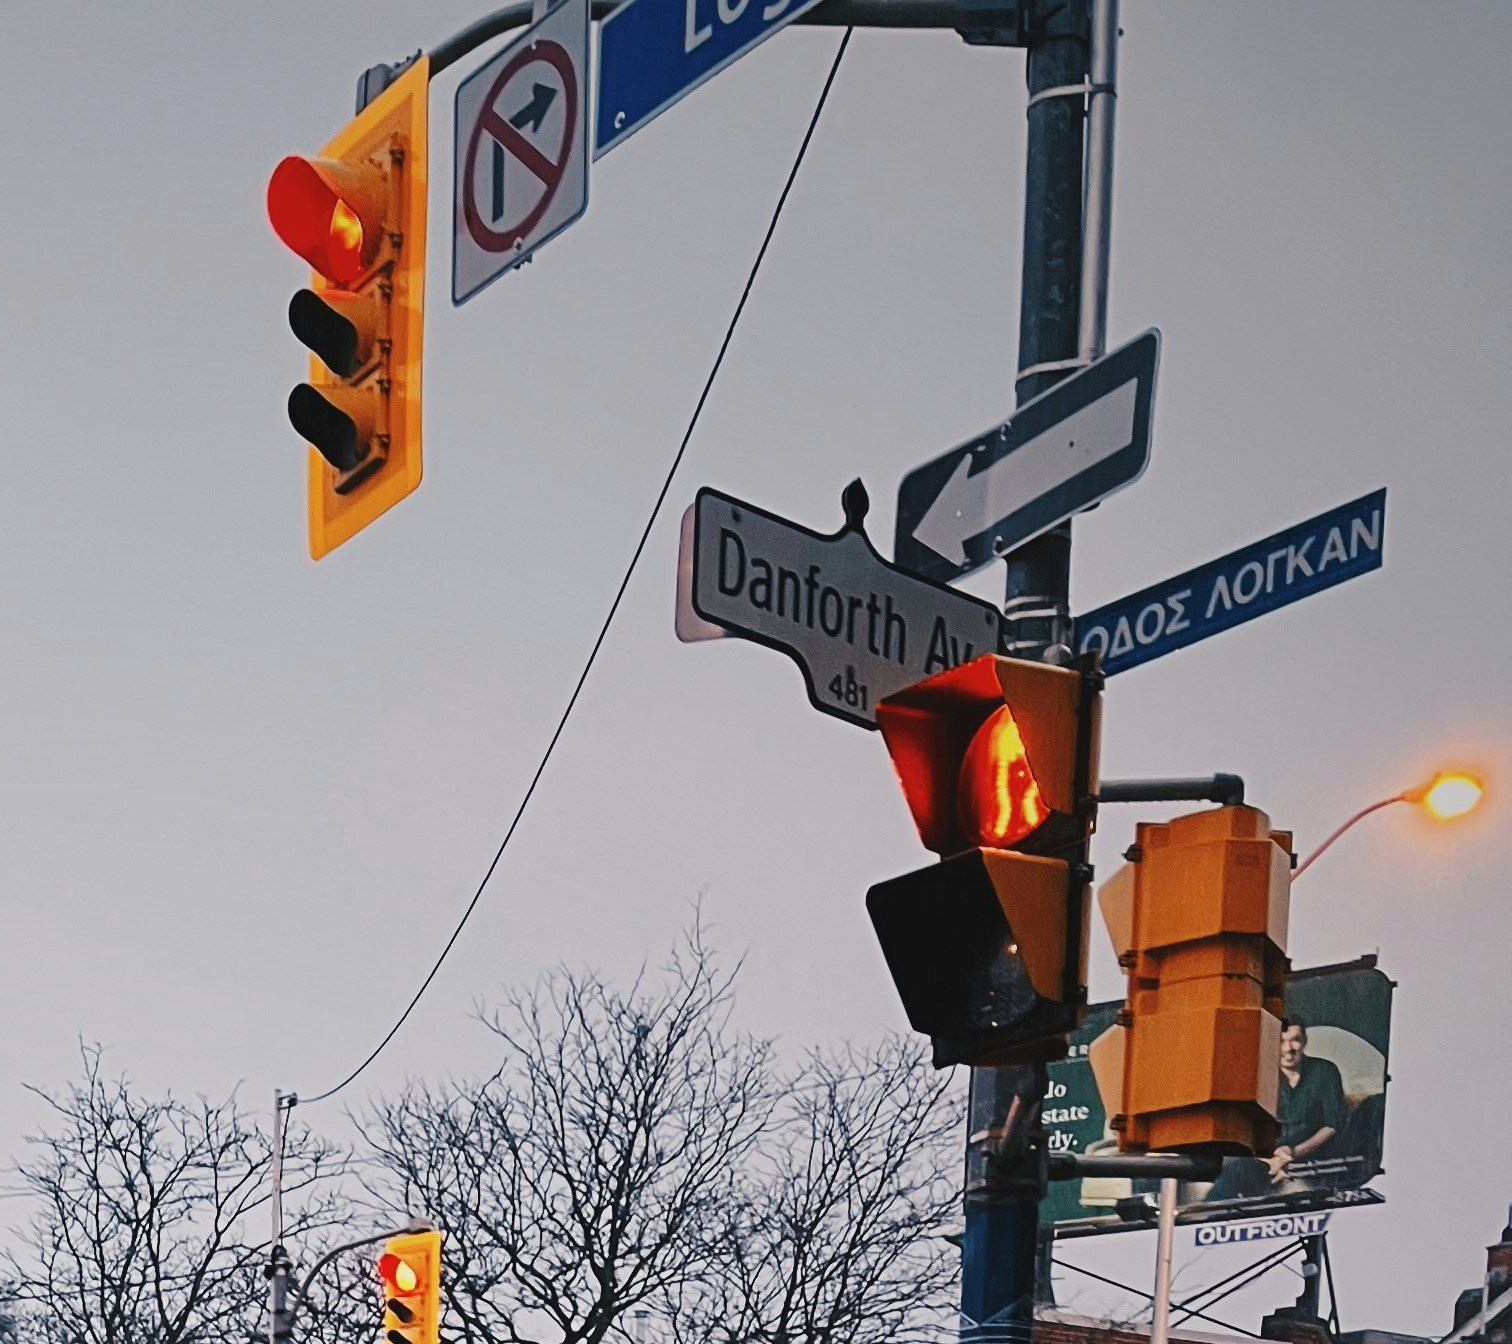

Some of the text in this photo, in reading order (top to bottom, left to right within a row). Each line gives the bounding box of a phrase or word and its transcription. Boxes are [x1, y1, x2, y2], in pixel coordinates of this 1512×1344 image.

[718, 526, 906, 665] Danforth
[1205, 510, 1380, 618] ΛΟΓΚΑΝ
[829, 672, 868, 711] 481
[1198, 1214, 1325, 1245] OUTFRONT
